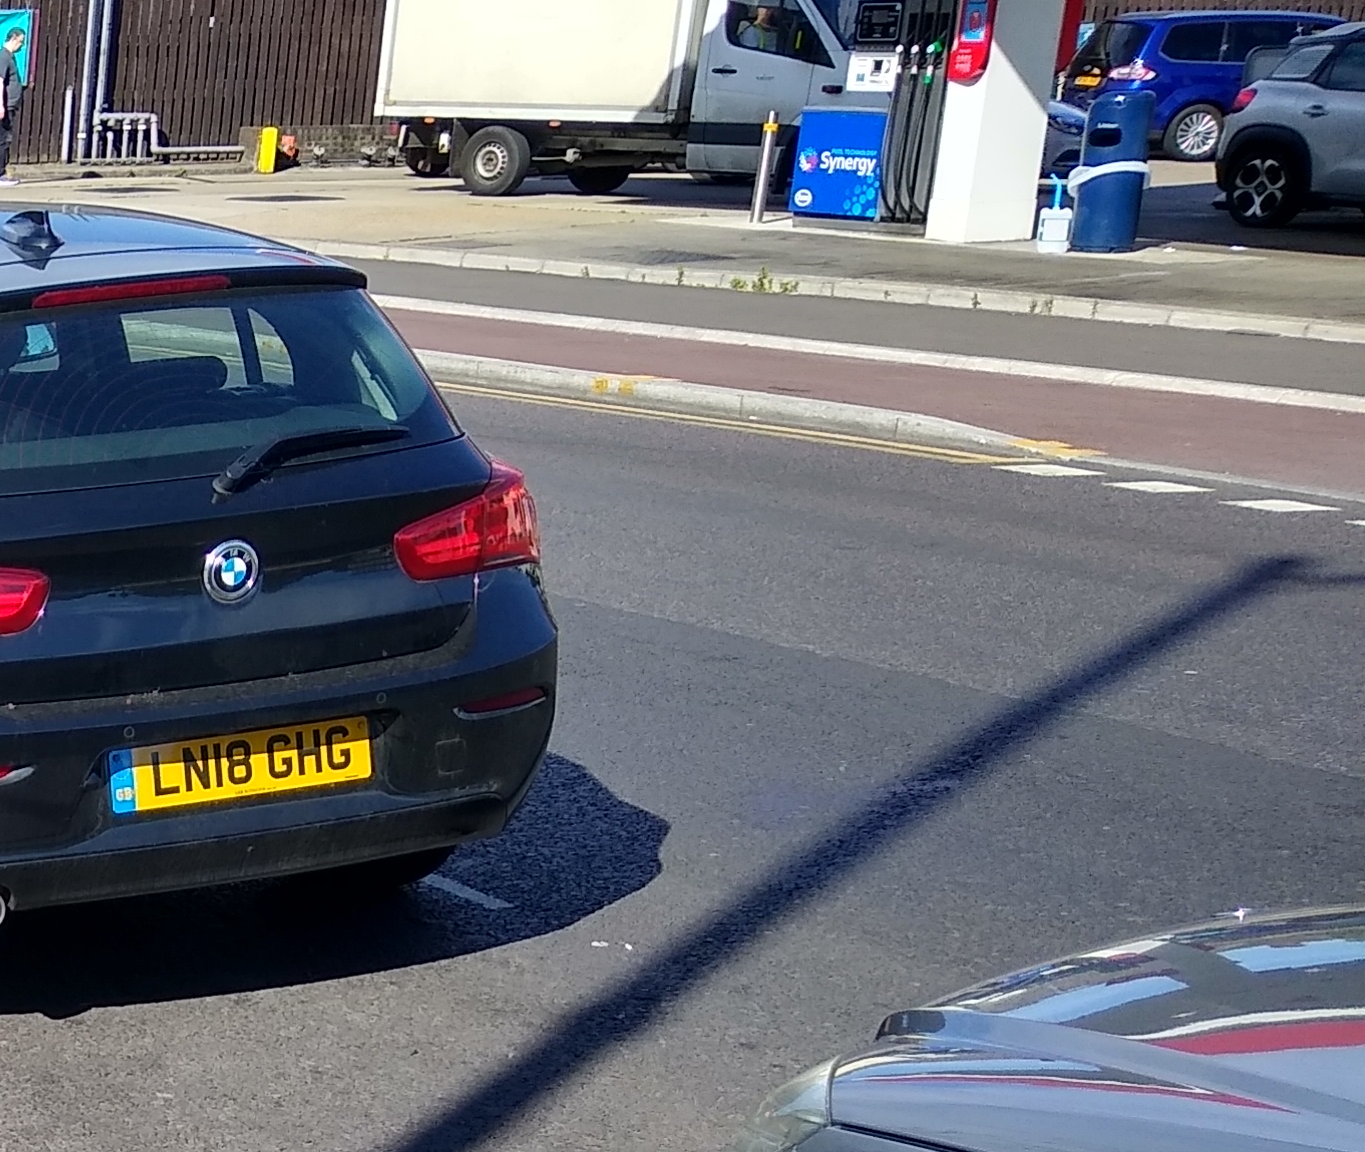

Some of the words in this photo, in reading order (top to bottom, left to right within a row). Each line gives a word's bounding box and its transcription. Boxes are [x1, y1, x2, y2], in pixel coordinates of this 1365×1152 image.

[819, 151, 877, 176] Synergy
[150, 738, 254, 798] LN18
[265, 724, 352, 780] GHG
